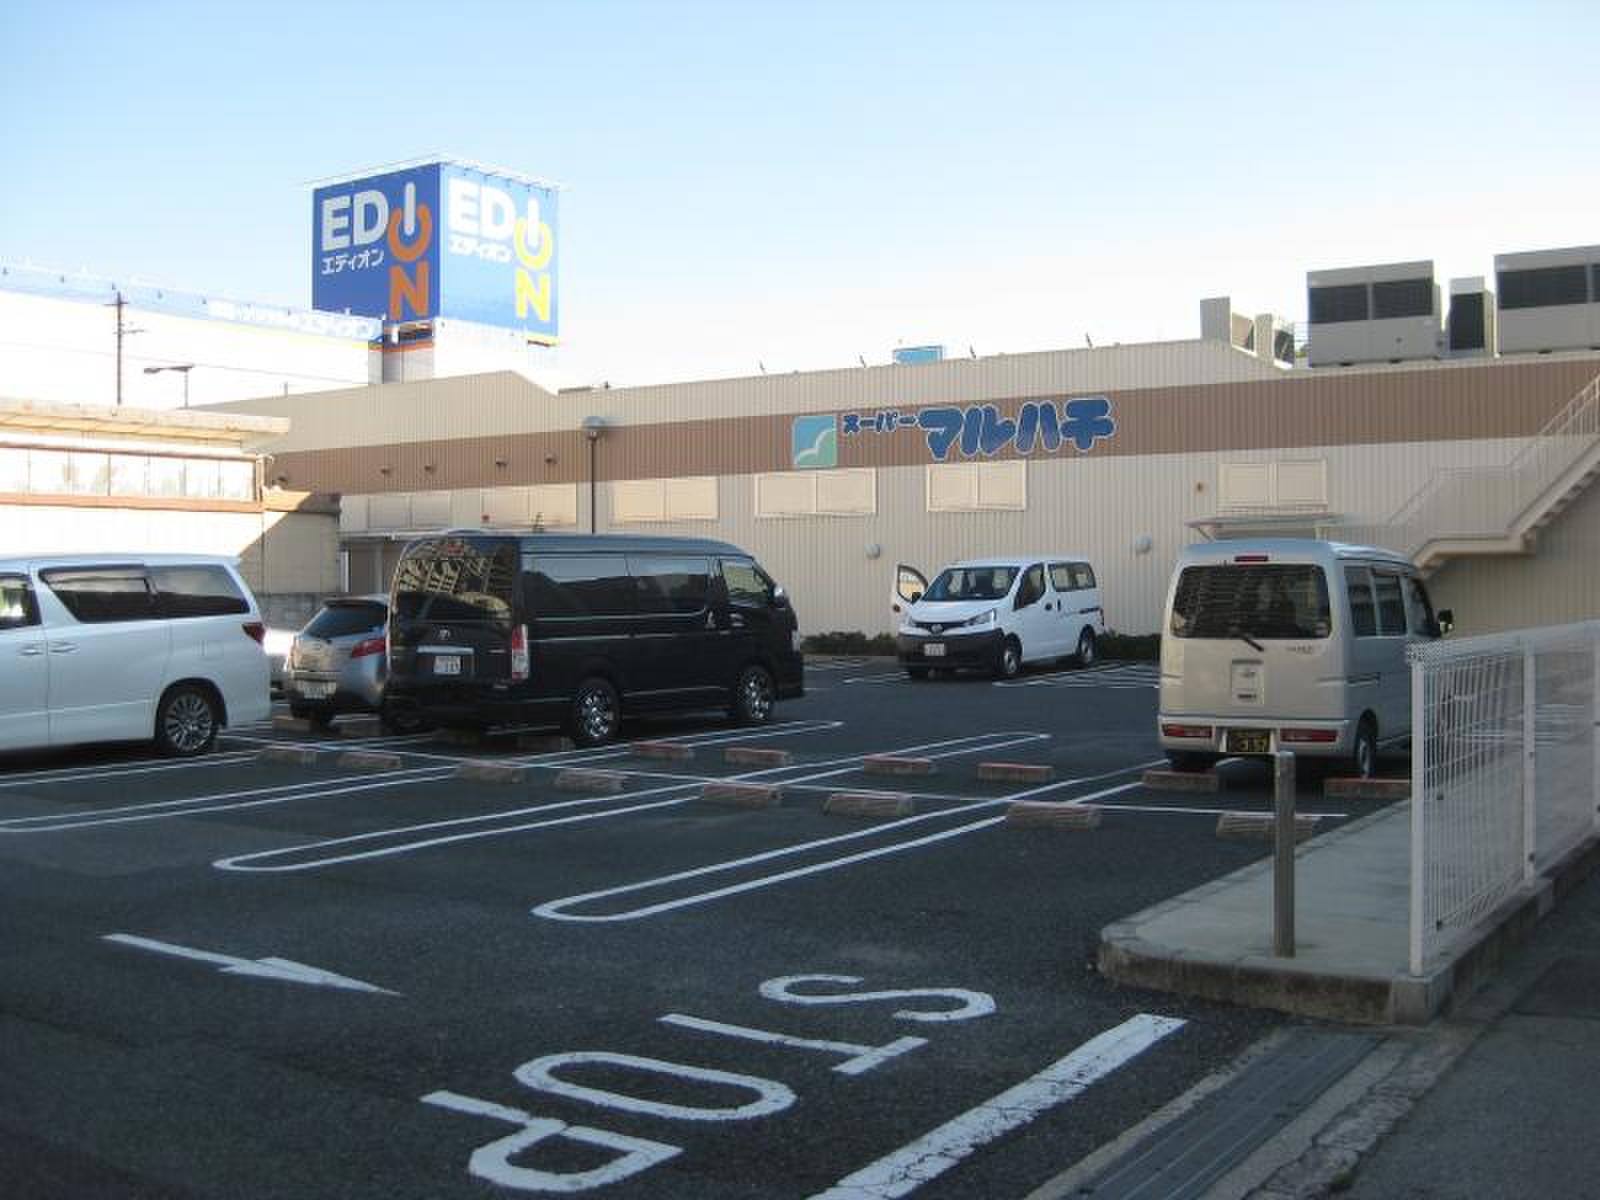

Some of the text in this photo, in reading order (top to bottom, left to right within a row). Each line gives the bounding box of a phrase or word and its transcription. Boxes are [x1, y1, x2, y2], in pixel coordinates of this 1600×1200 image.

[321, 248, 385, 276] エディオン
[420, 973, 998, 1193] STOP
